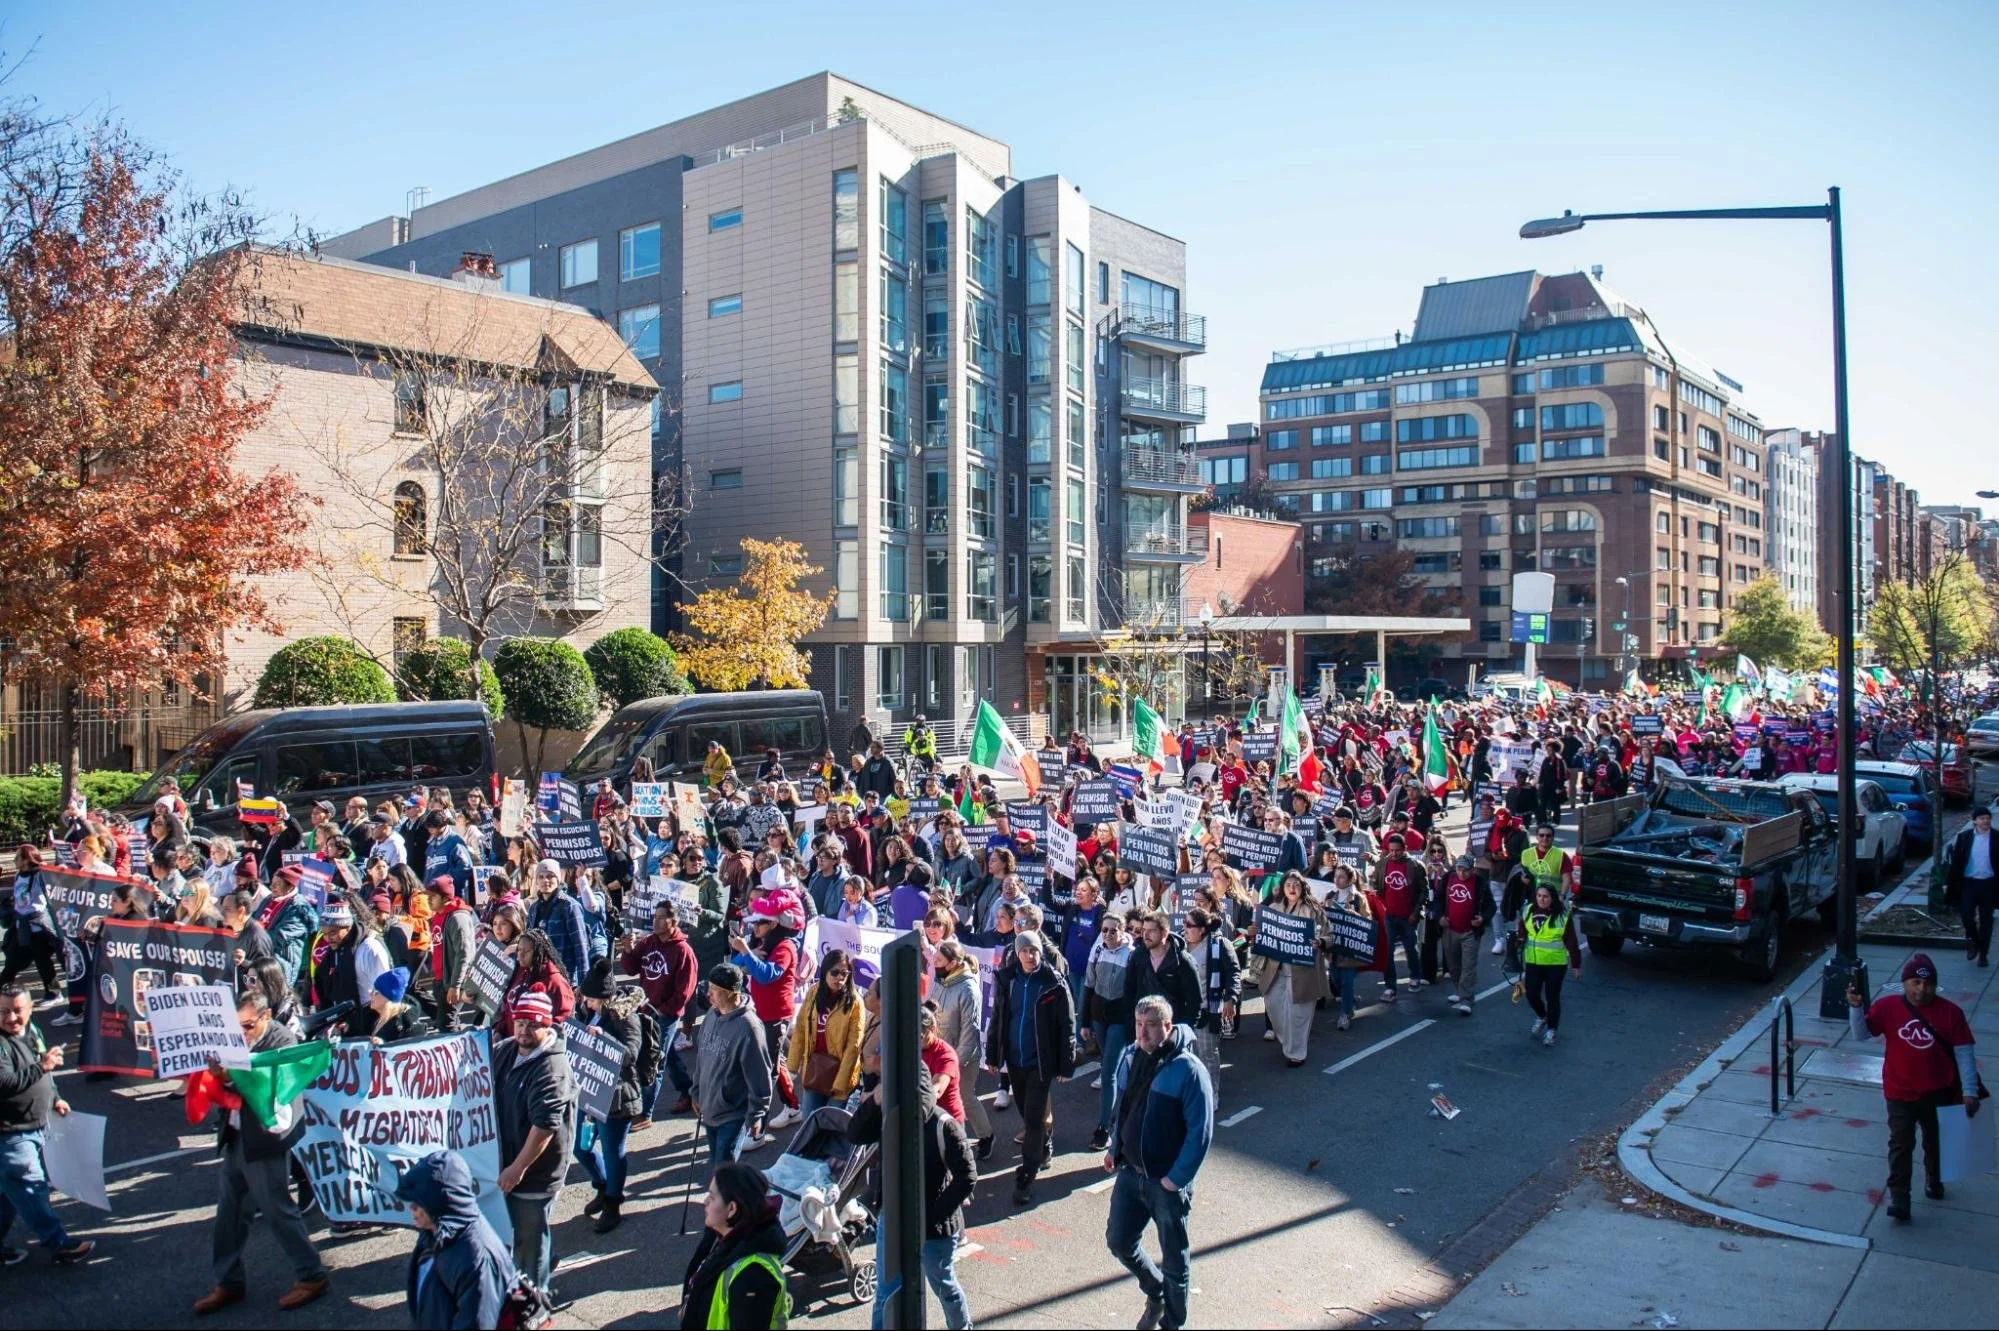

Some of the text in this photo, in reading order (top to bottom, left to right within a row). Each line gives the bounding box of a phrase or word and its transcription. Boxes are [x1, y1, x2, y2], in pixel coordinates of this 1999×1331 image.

[1077, 793, 1108, 803] PERMISOS
[1072, 805, 1089, 813] PARA
[1151, 805, 1174, 814] LLEVO
[560, 825, 591, 834] ESCUCHA!
[1152, 816, 1172, 825] AÑOS
[545, 837, 592, 848] PERMISOS
[1051, 826, 1069, 842] LLEVO
[1228, 827, 1258, 840] PRESIDENT
[544, 847, 603, 860] PARA TODOS!
[1126, 838, 1169, 857] PERMISOS
[1224, 836, 1279, 855] DREAMERS NEED
[1224, 845, 1276, 863] WORK PERMITS
[1121, 848, 1175, 871] PARA TODOS!
[45, 884, 68, 902] SAVE
[69, 889, 95, 907] OUR
[1278, 915, 1306, 928] ESCUCHA!
[1262, 922, 1304, 943] PERMISOS
[1330, 924, 1368, 942] ERMISOS
[846, 940, 861, 951] THE
[1255, 933, 1313, 957] PARA TODOS!
[1344, 938, 1374, 956] TODOS!
[106, 940, 227, 970] SAVE OUR SPOUSES
[477, 954, 508, 986] PERMISOS
[481, 978, 504, 1004] TODOS!
[148, 992, 222, 1011] BIDEN LLEVO
[198, 1010, 225, 1028] AÑOS
[158, 1032, 245, 1053] ESPERANDO UN
[563, 1022, 623, 1065] THE TIME IS NOW!
[368, 1050, 392, 1099] DE
[392, 1044, 457, 1099] TRABAJO
[450, 1035, 483, 1066] PARA
[578, 1057, 615, 1086] PERMITS
[458, 1066, 491, 1103] TODOS
[582, 1076, 600, 1096] ALL!
[340, 1108, 443, 1146] MIGRATORIO
[447, 1109, 464, 1150] HR
[467, 1103, 496, 1147] 1511
